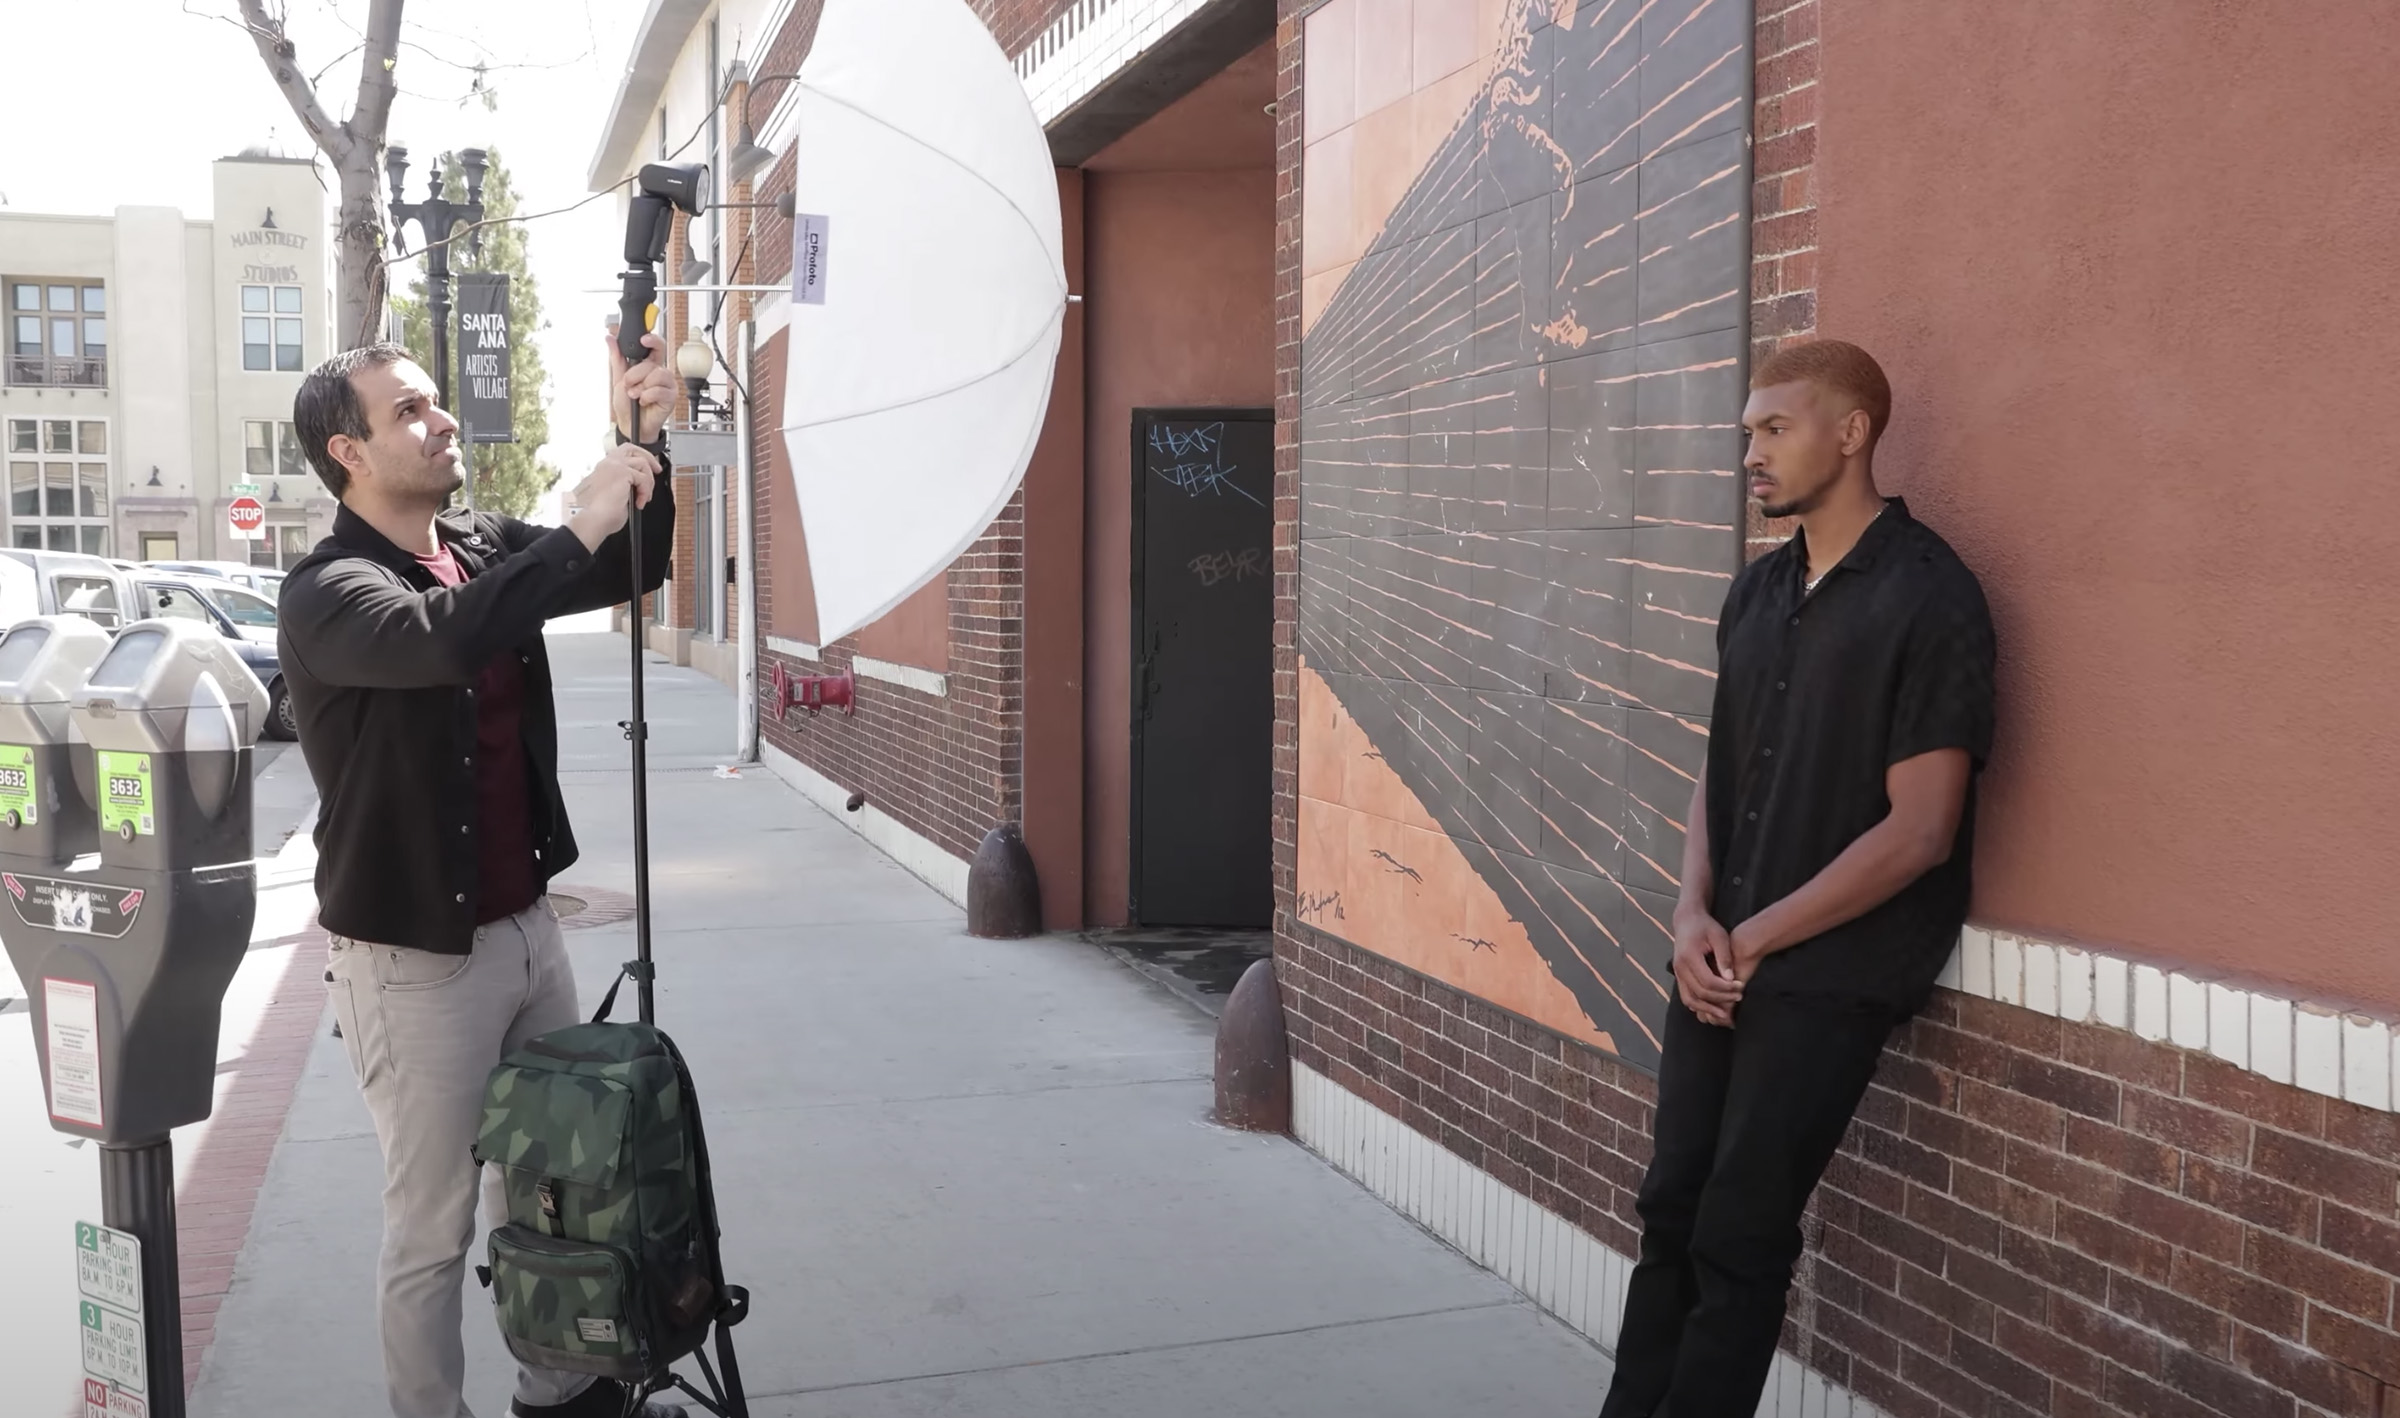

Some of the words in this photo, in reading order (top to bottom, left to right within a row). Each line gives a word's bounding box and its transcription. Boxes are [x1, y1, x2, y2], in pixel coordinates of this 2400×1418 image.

[230, 230, 262, 249] MAIN
[265, 230, 309, 250] STREET
[241, 263, 299, 283] STUDIOS
[808, 245, 818, 286] Profoto
[462, 313, 506, 331] SANTA
[478, 330, 506, 348] ANA
[465, 354, 498, 376] ARTISTS
[472, 377, 509, 399] VILLAGE
[231, 507, 261, 521] STOP
[0, 769, 26, 787] 3632
[110, 778, 141, 796] 3632
[35, 885, 55, 896] INSERT
[82, 1226, 92, 1247] 2
[106, 1242, 130, 1263] HOUR
[82, 1250, 112, 1274] PARKING
[115, 1261, 133, 1280] LIMIT
[104, 1274, 113, 1290] TO
[87, 1305, 96, 1327] 3
[109, 1320, 134, 1343] HOUR
[86, 1329, 117, 1354] PARKING
[120, 1341, 137, 1361] LIMIT
[107, 1353, 116, 1369] TO
[87, 1380, 104, 1404] NO
[109, 1393, 142, 1418] PARKING
